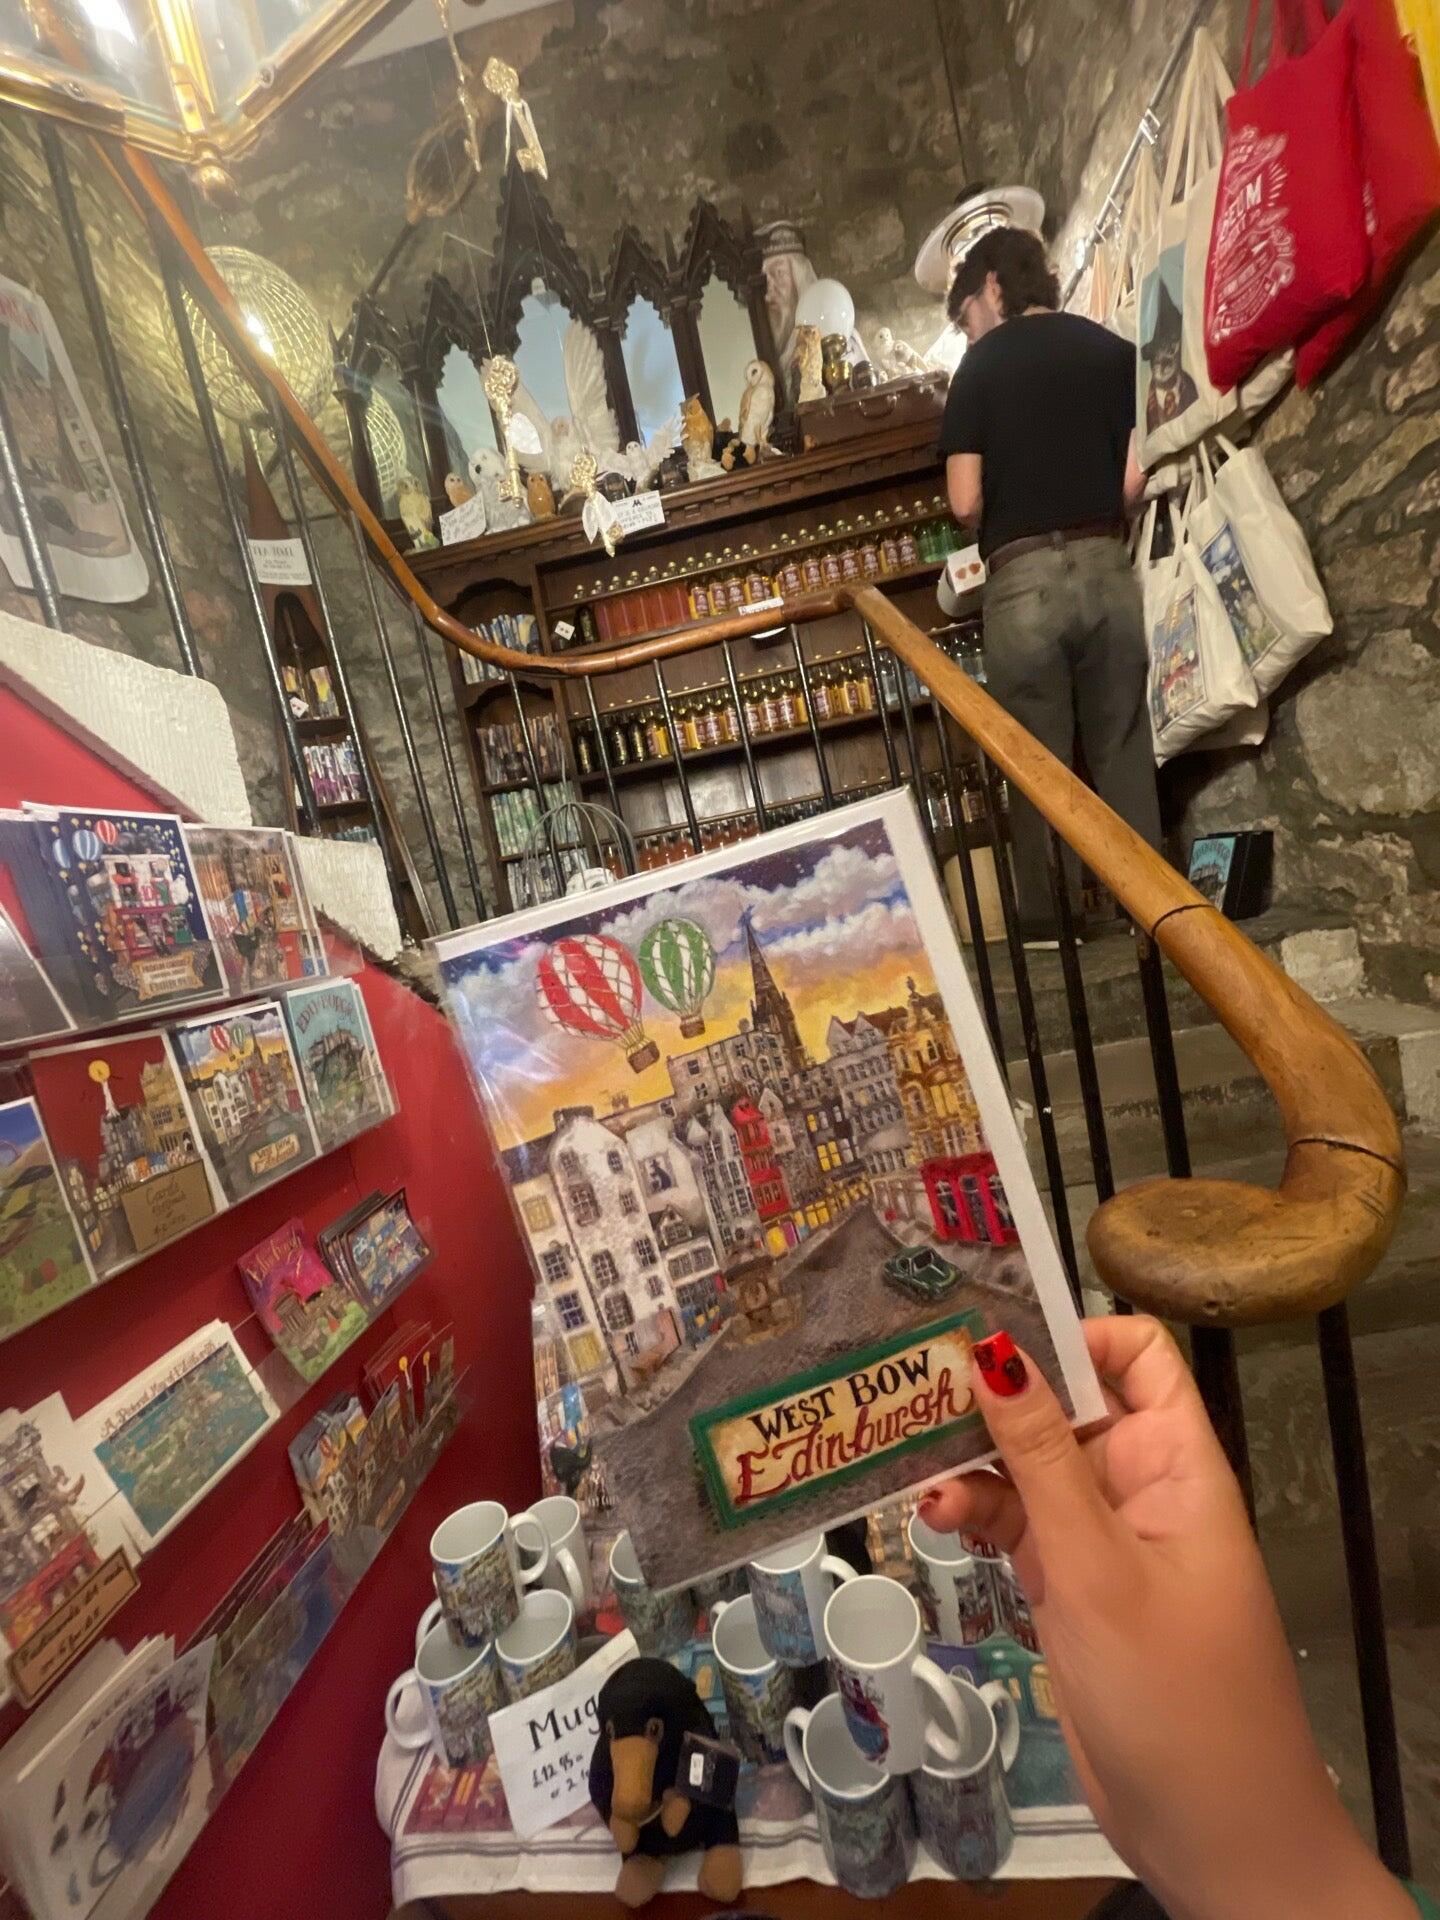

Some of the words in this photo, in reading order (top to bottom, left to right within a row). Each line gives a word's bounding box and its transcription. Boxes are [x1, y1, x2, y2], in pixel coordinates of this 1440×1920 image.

[734, 1367, 975, 1505] Edinburgh
[749, 1387, 835, 1444] WEST
[847, 1349, 930, 1408] BOW
